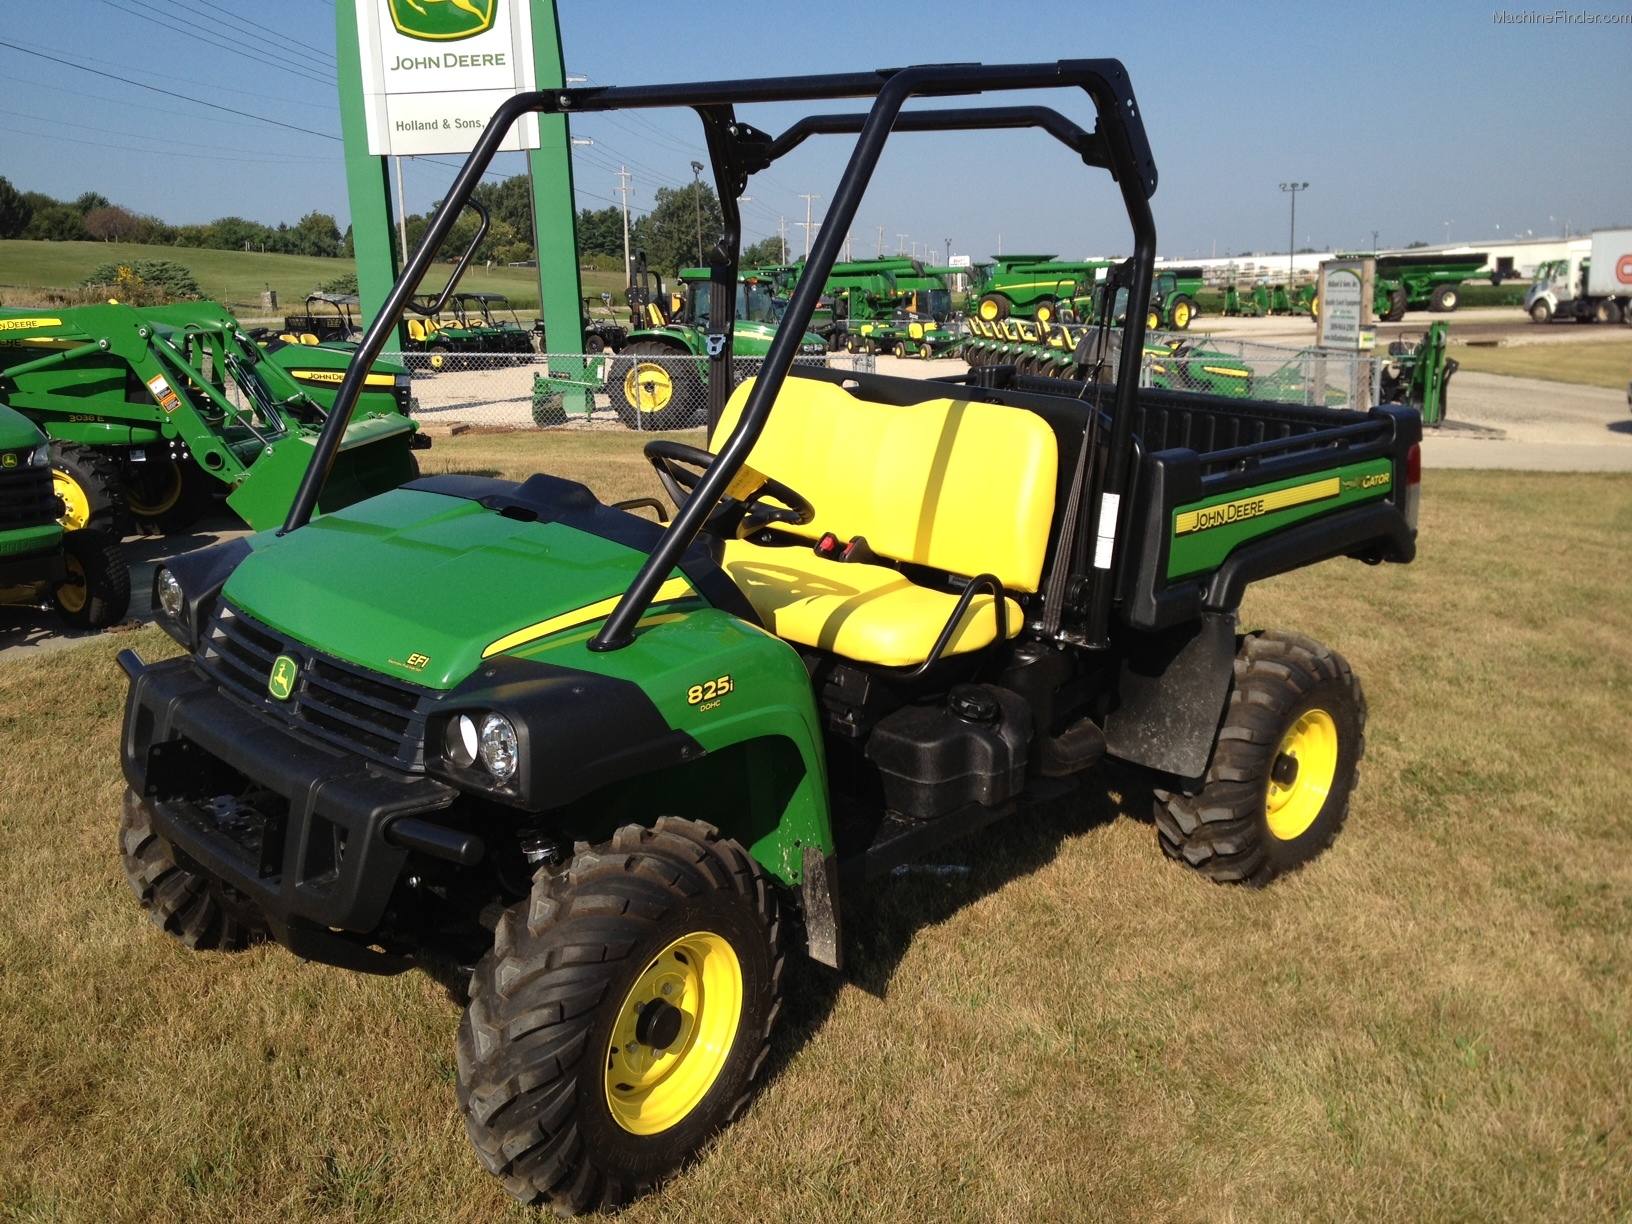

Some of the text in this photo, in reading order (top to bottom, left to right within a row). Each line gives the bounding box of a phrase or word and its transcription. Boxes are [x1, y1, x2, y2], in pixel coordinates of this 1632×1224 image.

[390, 53, 506, 71] JOHN DEERE
[396, 118, 486, 132] Holland & Sons,
[7, 320, 38, 329] DEERE
[308, 372, 332, 380] JOHN
[68, 414, 96, 423] 3038
[1362, 473, 1390, 489] GATOR
[1192, 499, 1265, 531] JOHN DEERE
[407, 652, 431, 668] EFI
[687, 675, 734, 705] 825i
[700, 699, 721, 712] DOHC
